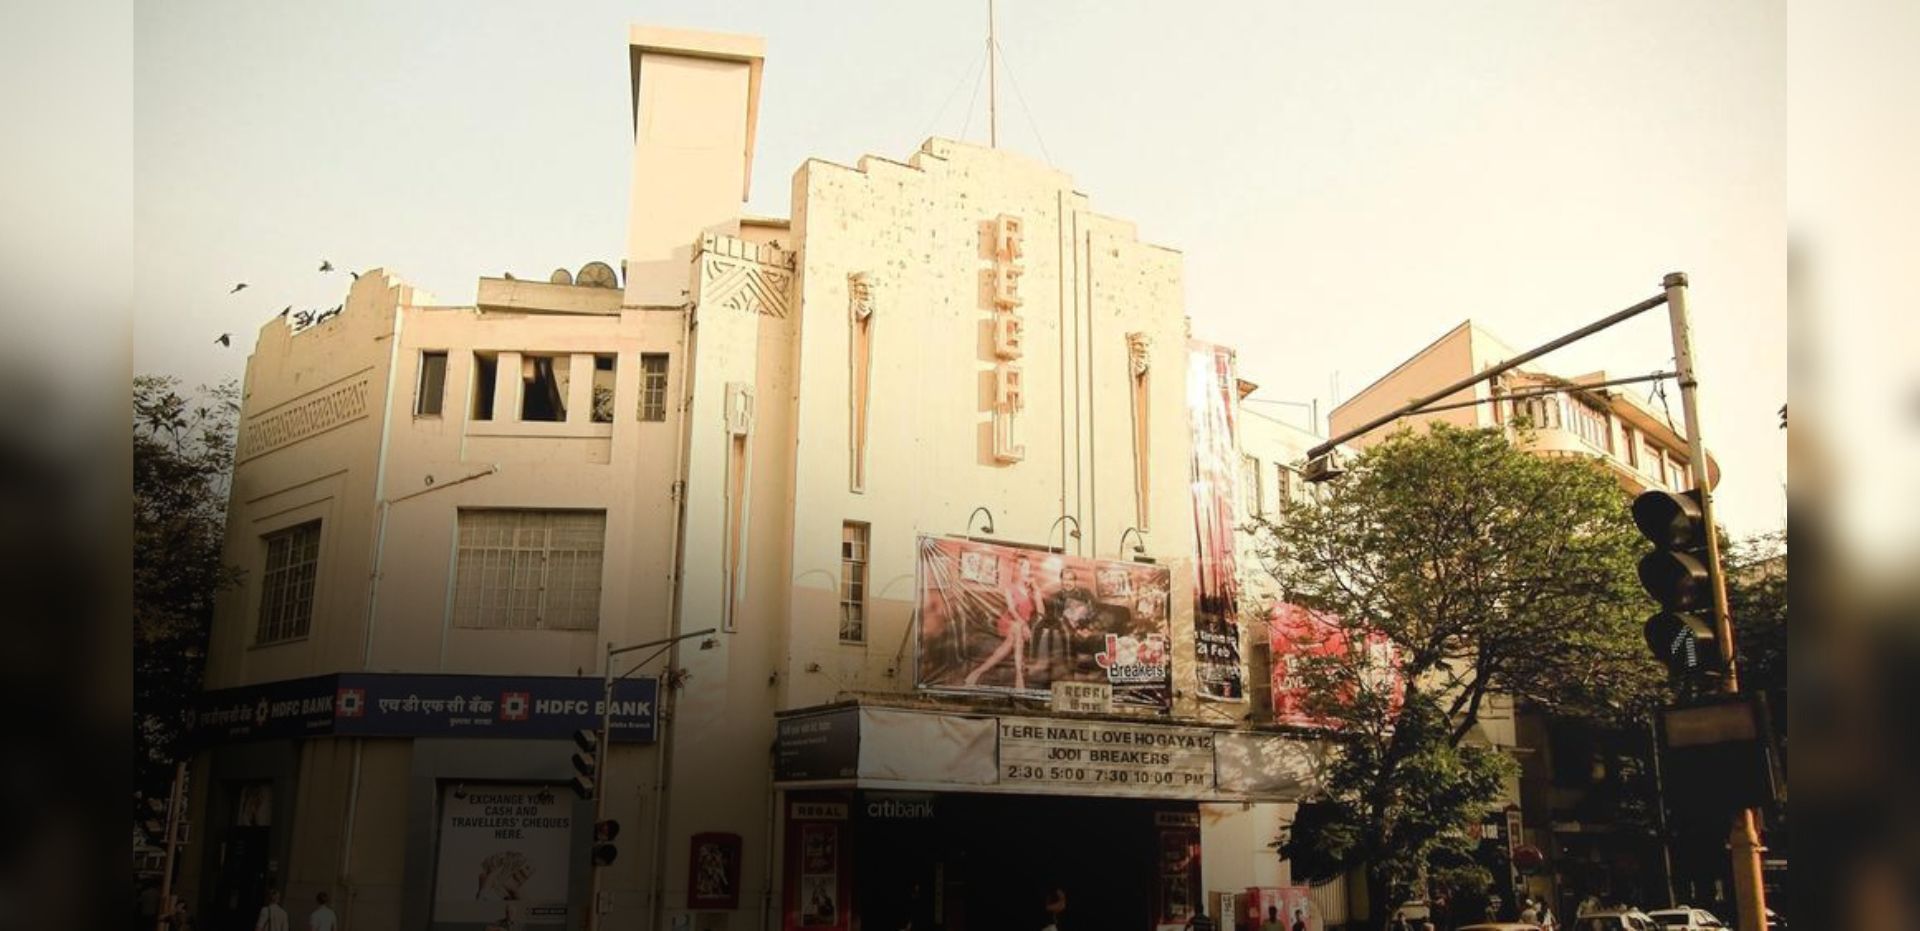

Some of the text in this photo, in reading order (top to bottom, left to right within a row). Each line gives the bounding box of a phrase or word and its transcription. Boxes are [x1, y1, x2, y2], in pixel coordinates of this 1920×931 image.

[993, 212, 1025, 463] REGAL
[1110, 662, 1164, 678] Breakers
[1277, 675, 1306, 690] LOVE
[271, 700, 300, 719] HDFC
[301, 694, 334, 715] BANK
[535, 699, 651, 716] HDFC BANK
[1002, 724, 1043, 738] TERE
[1047, 727, 1089, 742] NAAL
[1093, 730, 1131, 744] LOVE
[1048, 747, 1170, 765] JODI BREAKERS
[1008, 765, 1044, 779] 2:30
[1050, 766, 1085, 781] 5:00
[1095, 769, 1128, 783] 7:30
[1184, 772, 1204, 784] PM
[470, 794, 526, 806] EXCHANGE
[484, 805, 537, 817] CASH AND
[798, 806, 841, 817] REGAL
[866, 799, 935, 820] citibank
[451, 817, 569, 829] TRAVELLERS' CHEQUES
[494, 828, 525, 840] HERE.
